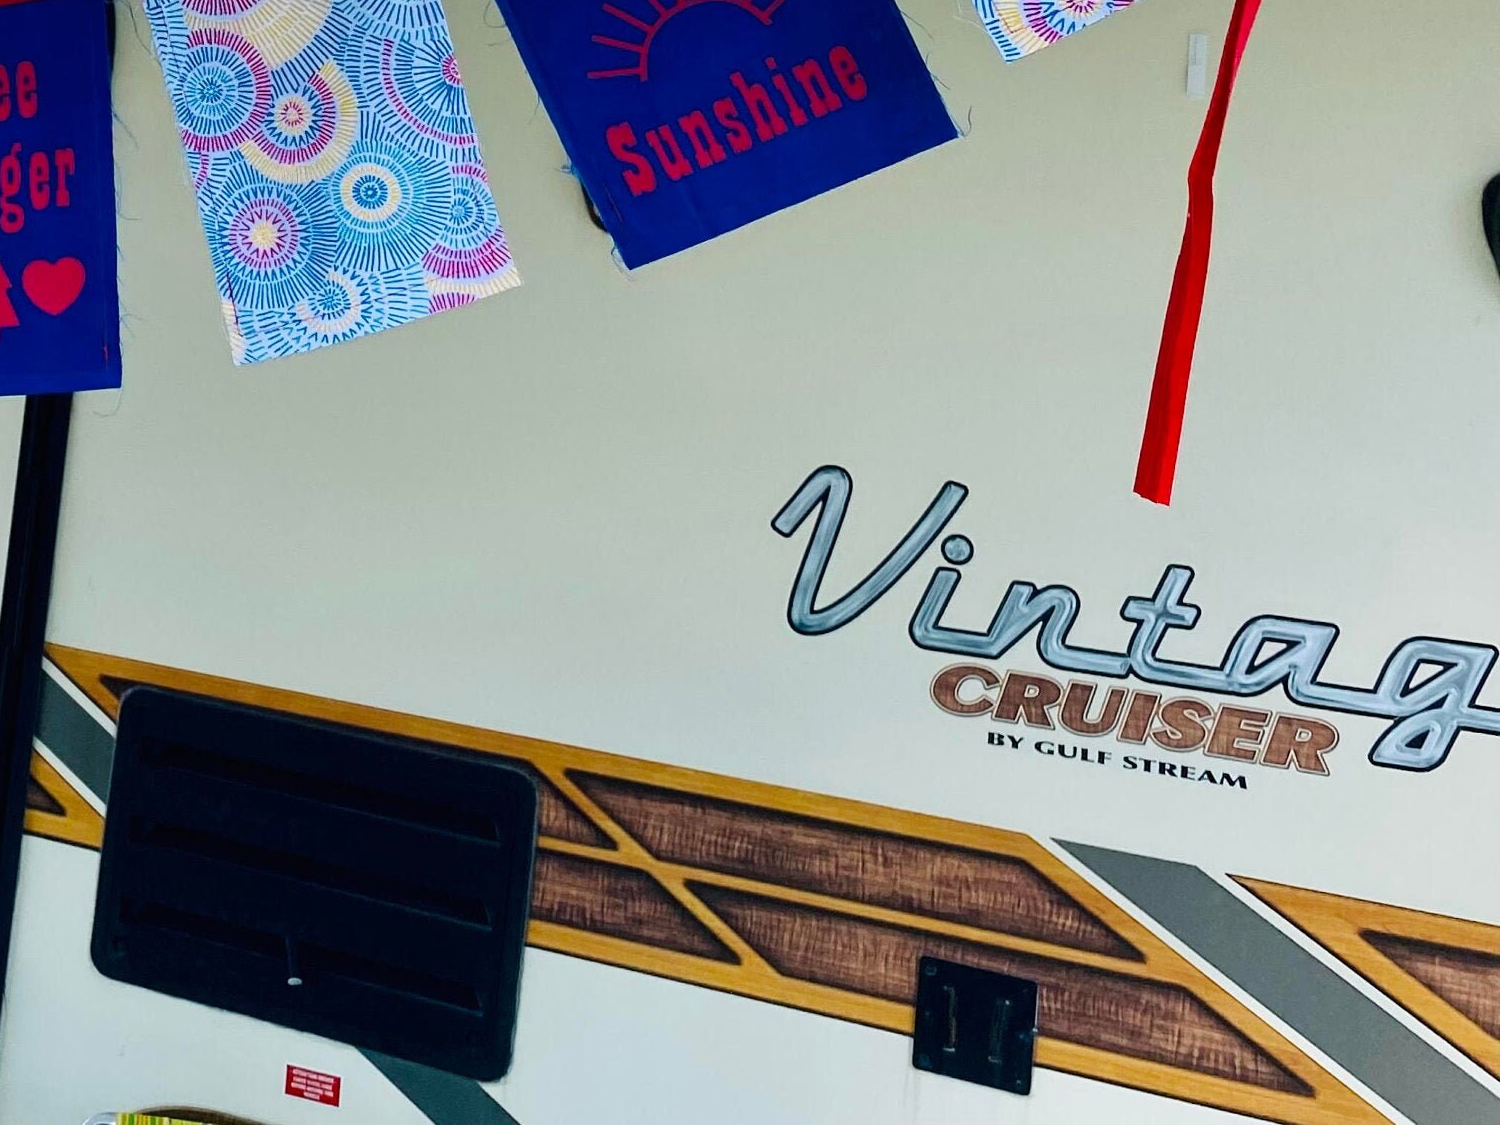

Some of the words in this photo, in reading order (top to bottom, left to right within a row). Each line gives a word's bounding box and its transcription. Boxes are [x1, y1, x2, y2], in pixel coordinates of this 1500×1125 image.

[605, 45, 868, 196] Sunshine
[771, 465, 1500, 773] Vintag
[929, 662, 1340, 776] CRUISER
[986, 732, 1024, 751] BY
[1034, 740, 1112, 765] GULF
[1122, 755, 1248, 790] STREAM
